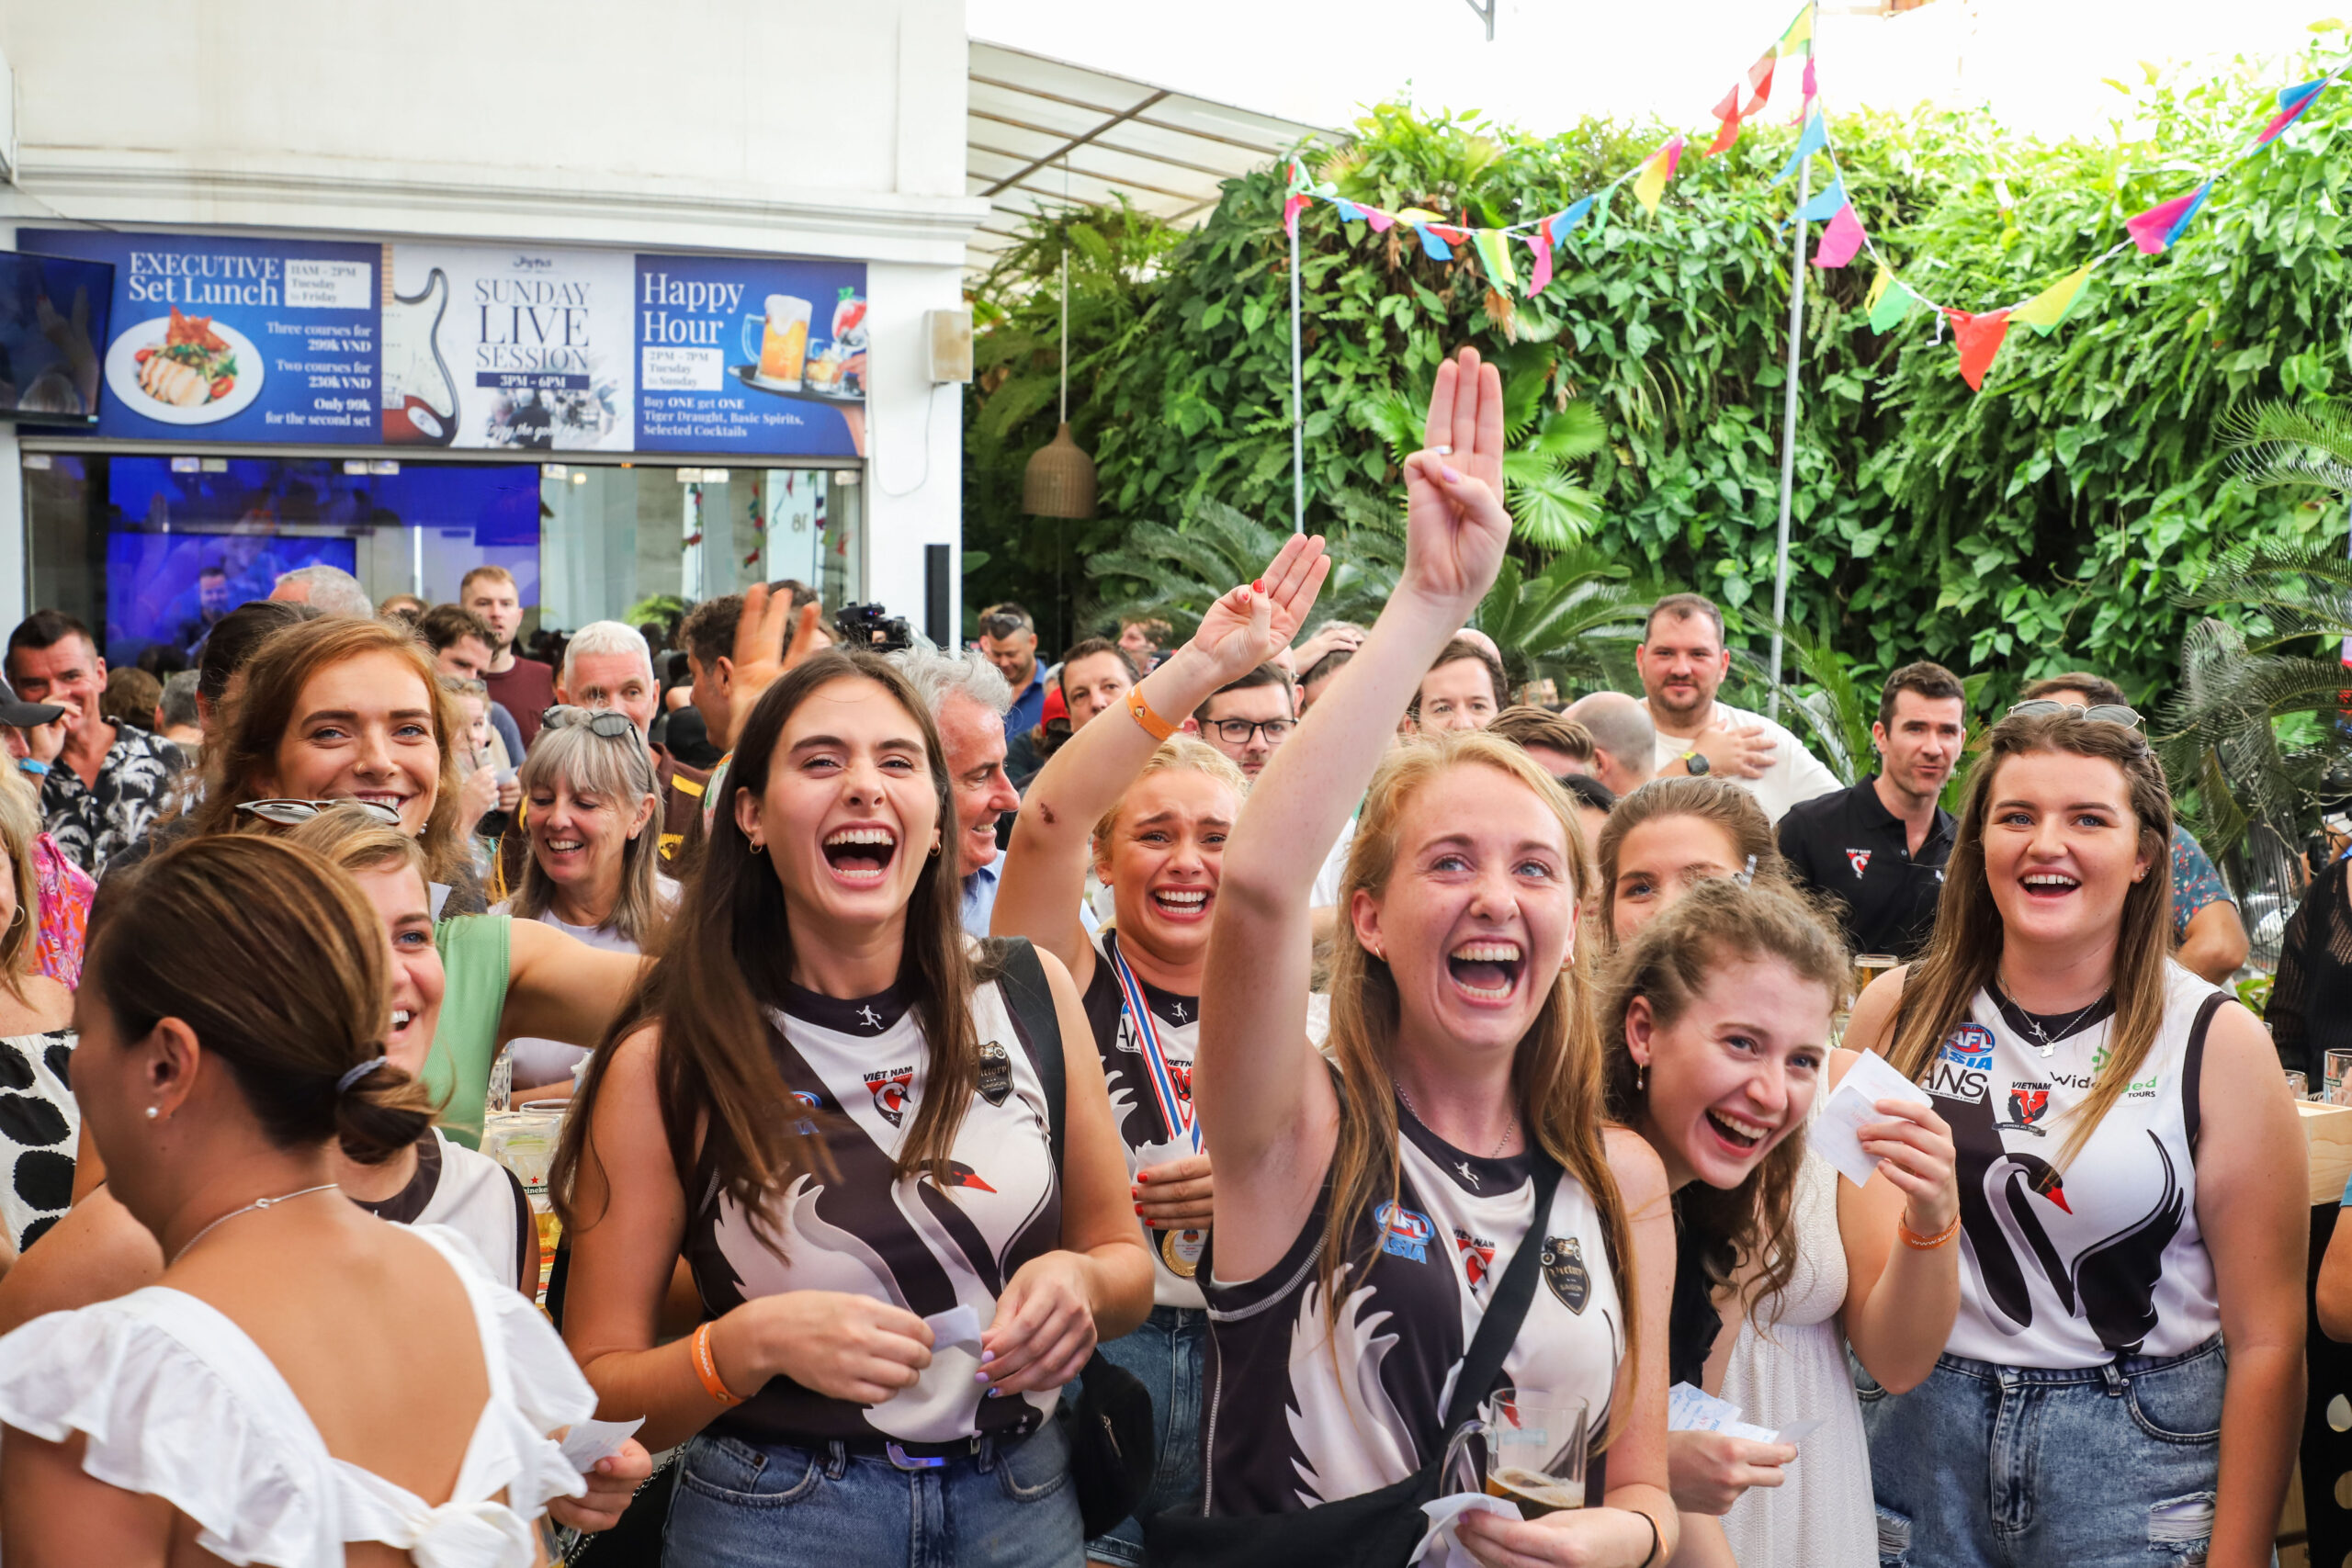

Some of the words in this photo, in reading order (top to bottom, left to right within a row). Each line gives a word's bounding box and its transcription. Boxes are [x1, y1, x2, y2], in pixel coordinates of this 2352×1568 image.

[130, 252, 279, 279] EXECUTIVE
[331, 265, 356, 276] 2PM
[129, 275, 178, 303] Set
[184, 276, 278, 306] Lunch
[292, 277, 335, 290] Tuesday
[302, 291, 337, 304] Friday
[474, 277, 591, 306] SUNDAY
[643, 273, 745, 314] Happy
[266, 321, 302, 335] Three
[304, 325, 352, 337] courses
[353, 323, 372, 337] for
[478, 304, 590, 347] LIVE
[643, 310, 724, 344] Hour
[342, 339, 372, 353] VND
[476, 346, 589, 371] SESSION
[649, 351, 674, 361] 2PM
[686, 352, 709, 362] 7PM
[277, 358, 303, 372] Two
[304, 362, 352, 374] courses
[353, 360, 372, 374] for
[649, 363, 691, 376] Tuesday
[342, 377, 372, 389] VND
[499, 375, 527, 388] 3PM
[538, 376, 567, 389] 6PM
[660, 377, 698, 389] Sunday
[314, 397, 345, 412] Only
[345, 398, 371, 412] 99k
[644, 396, 665, 410] Buy
[668, 397, 695, 410] ONE
[697, 399, 717, 412] get
[718, 399, 745, 411] ONE
[266, 411, 284, 424] for
[286, 411, 306, 425] the
[308, 413, 351, 426] second
[353, 414, 371, 427] set
[644, 411, 673, 423] Tiger
[676, 412, 728, 425] Draught,
[730, 412, 761, 424] Basic
[763, 413, 805, 427] Spirits,
[643, 424, 693, 437] Selected
[695, 426, 748, 438] Cocktails
[1166, 1057, 1193, 1067] VIETN
[889, 1066, 913, 1077] NAM
[2012, 1081, 2052, 1090] VIETNAM
[2128, 1090, 2156, 1099] TOURS
[1473, 1237, 1496, 1248] NAM
